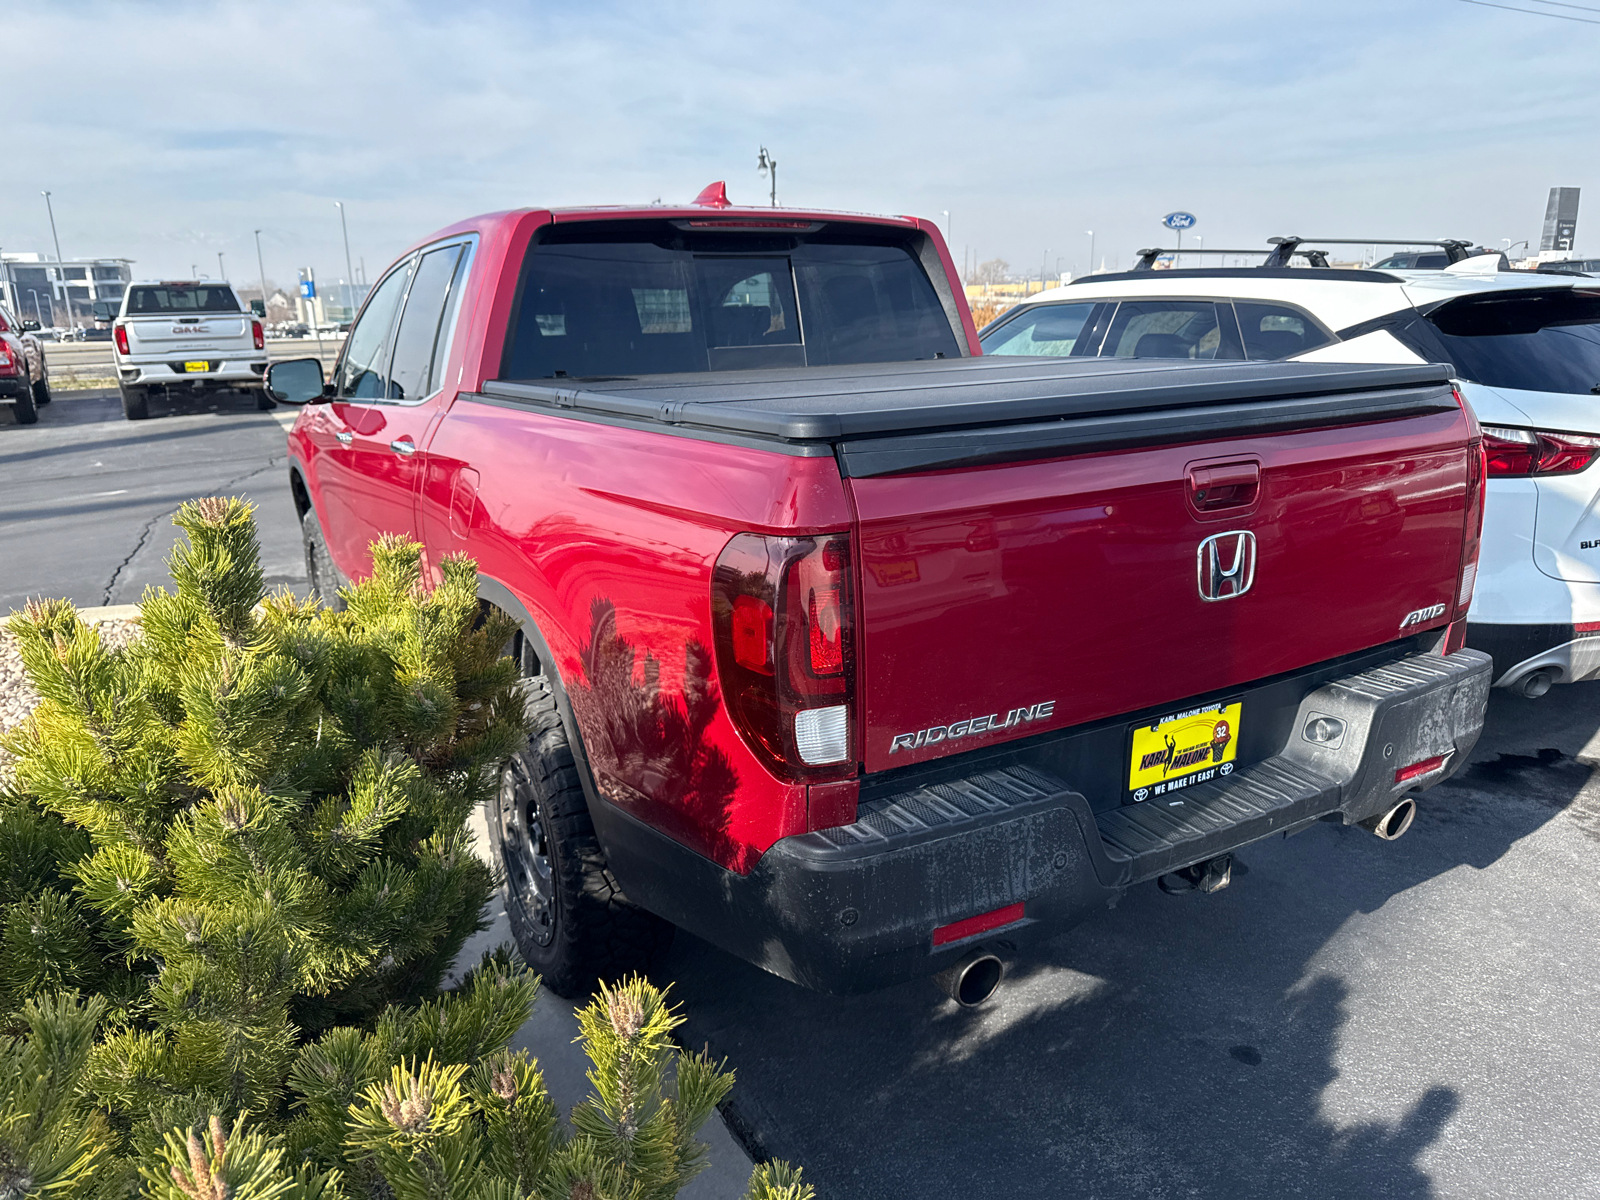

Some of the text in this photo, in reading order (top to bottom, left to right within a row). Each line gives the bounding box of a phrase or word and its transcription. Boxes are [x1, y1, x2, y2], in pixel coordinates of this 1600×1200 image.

[1171, 214, 1191, 227] Ford
[172, 326, 210, 334] GMC
[1399, 603, 1446, 628] AWD
[1159, 702, 1222, 725] KARL MALONE TOYOTA
[888, 700, 1056, 755] RIDGELINE
[1216, 725, 1227, 738] 32
[1139, 749, 1168, 771] KARL
[1169, 746, 1211, 771] MALONE
[1154, 769, 1215, 795] WE MAKE IT EASY
